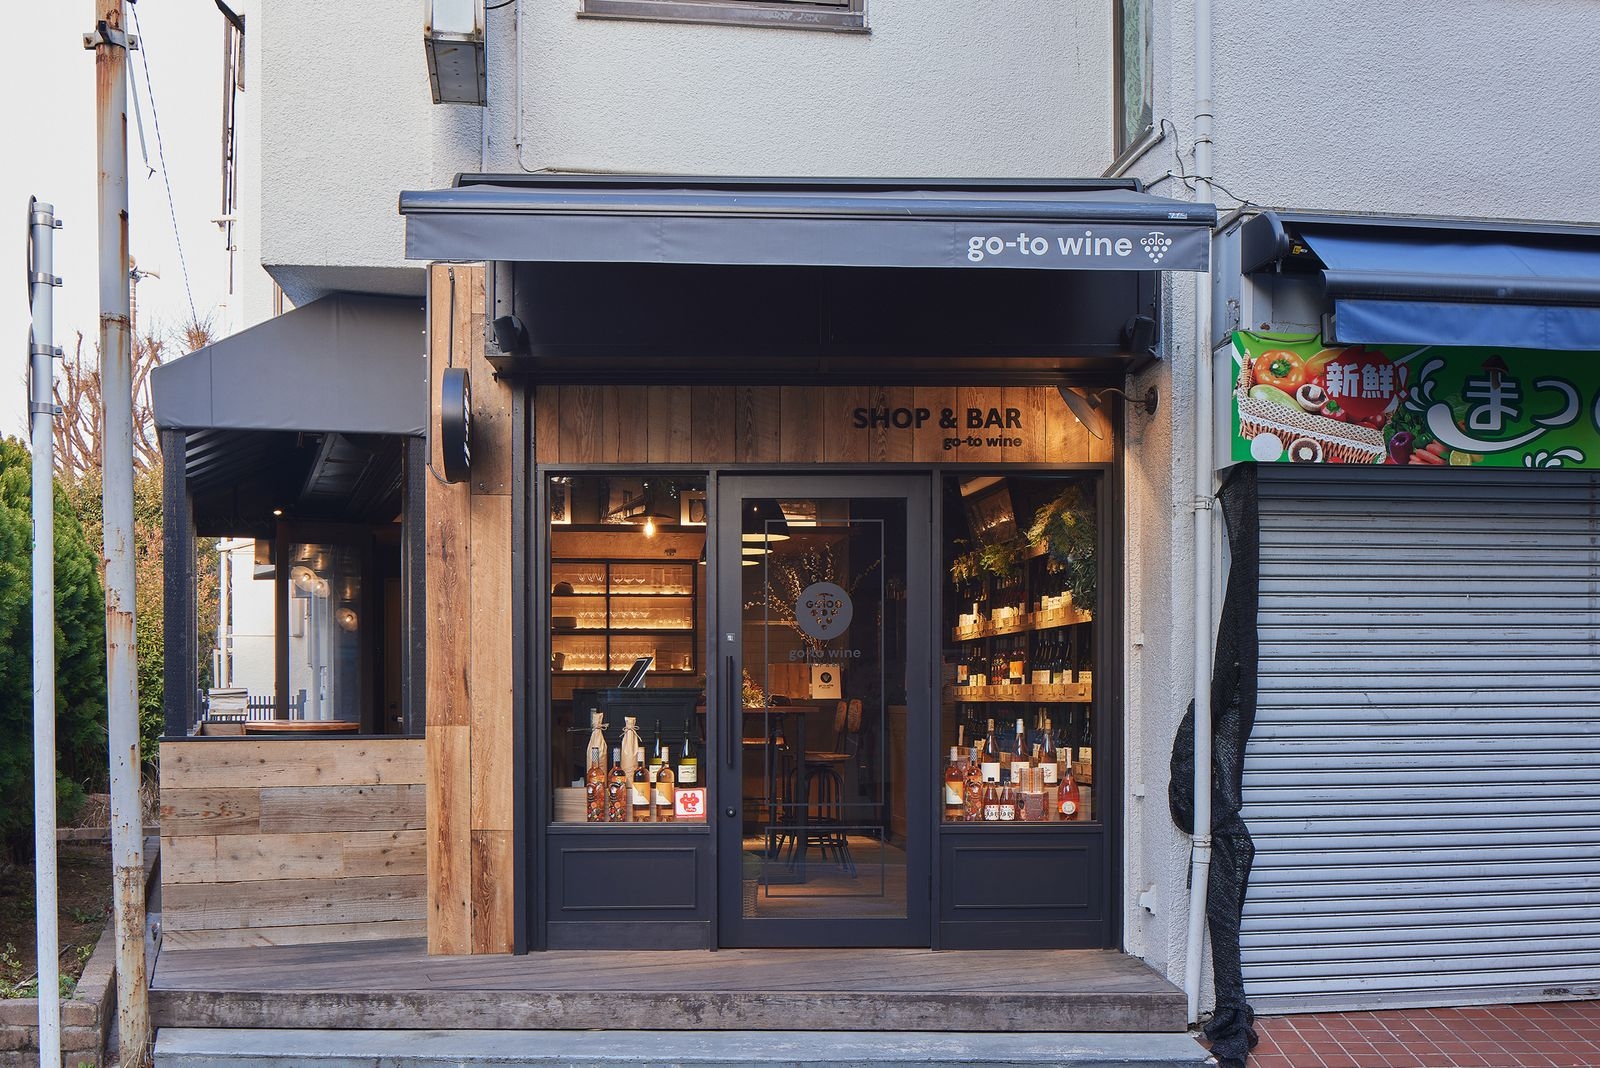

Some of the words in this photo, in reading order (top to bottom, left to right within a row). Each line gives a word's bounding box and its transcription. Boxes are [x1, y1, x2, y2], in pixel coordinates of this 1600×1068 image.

[967, 232, 1049, 262] go-to
[1057, 230, 1133, 257] wine
[1466, 368, 1600, 431] まつ
[853, 407, 930, 429] SHOP
[939, 407, 958, 429] &
[967, 408, 1022, 429] BAR
[943, 435, 982, 450] go-to
[986, 434, 1022, 447] wine
[828, 646, 862, 658] wine
